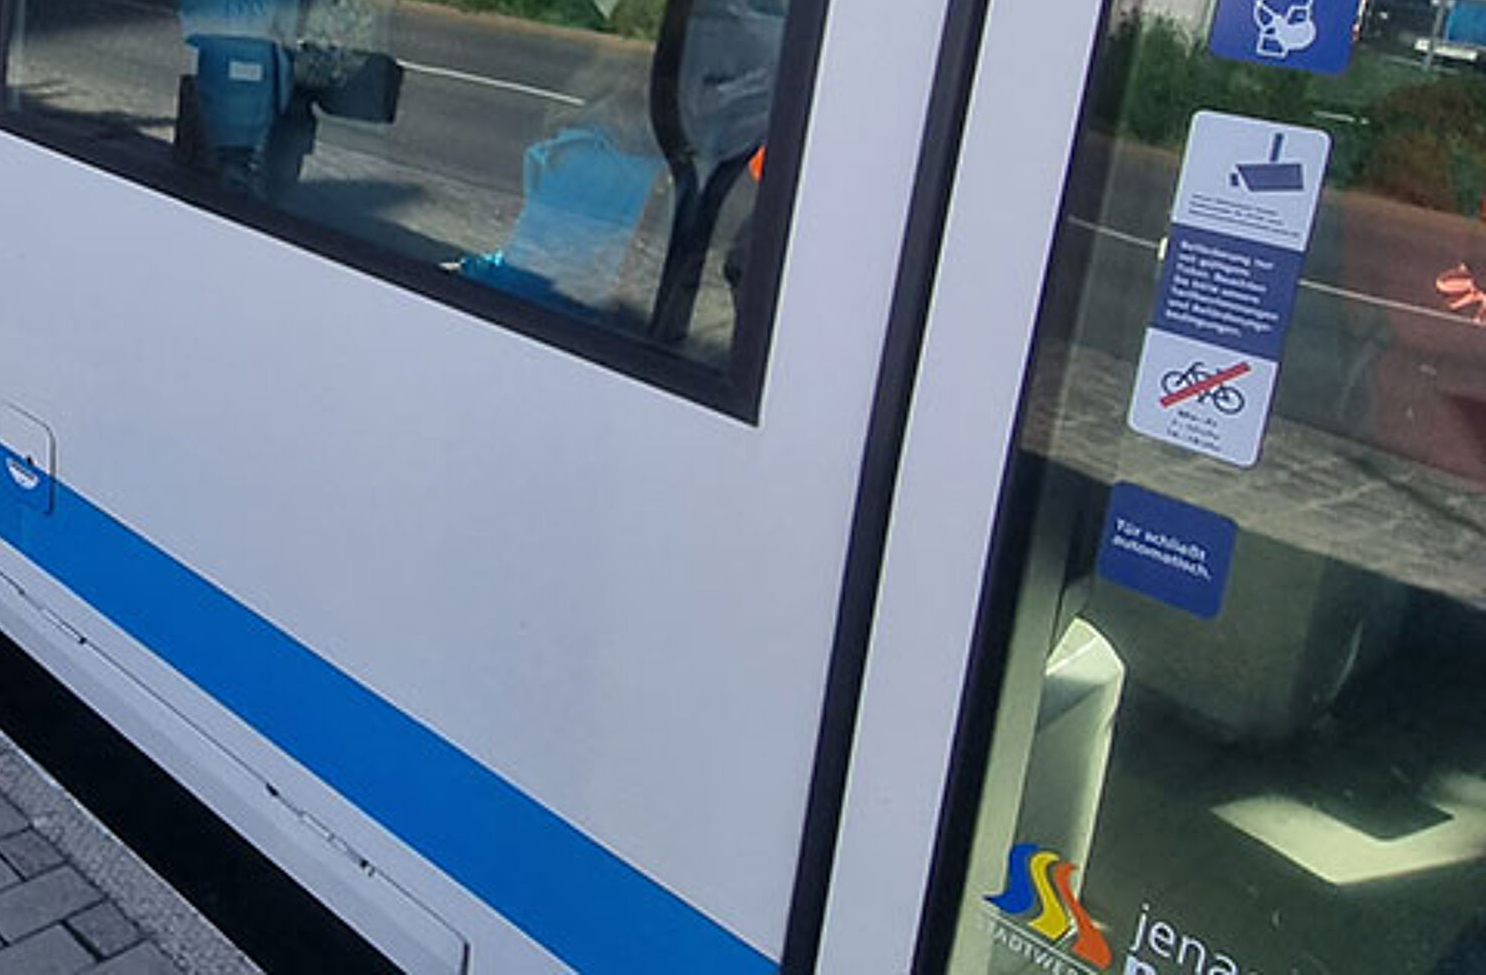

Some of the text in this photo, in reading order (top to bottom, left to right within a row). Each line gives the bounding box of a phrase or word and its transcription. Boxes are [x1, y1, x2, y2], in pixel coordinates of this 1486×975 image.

[1112, 534, 1213, 582] automatisch.
[1116, 517, 1206, 562] Tür schließt
[1128, 902, 1259, 975] jena
